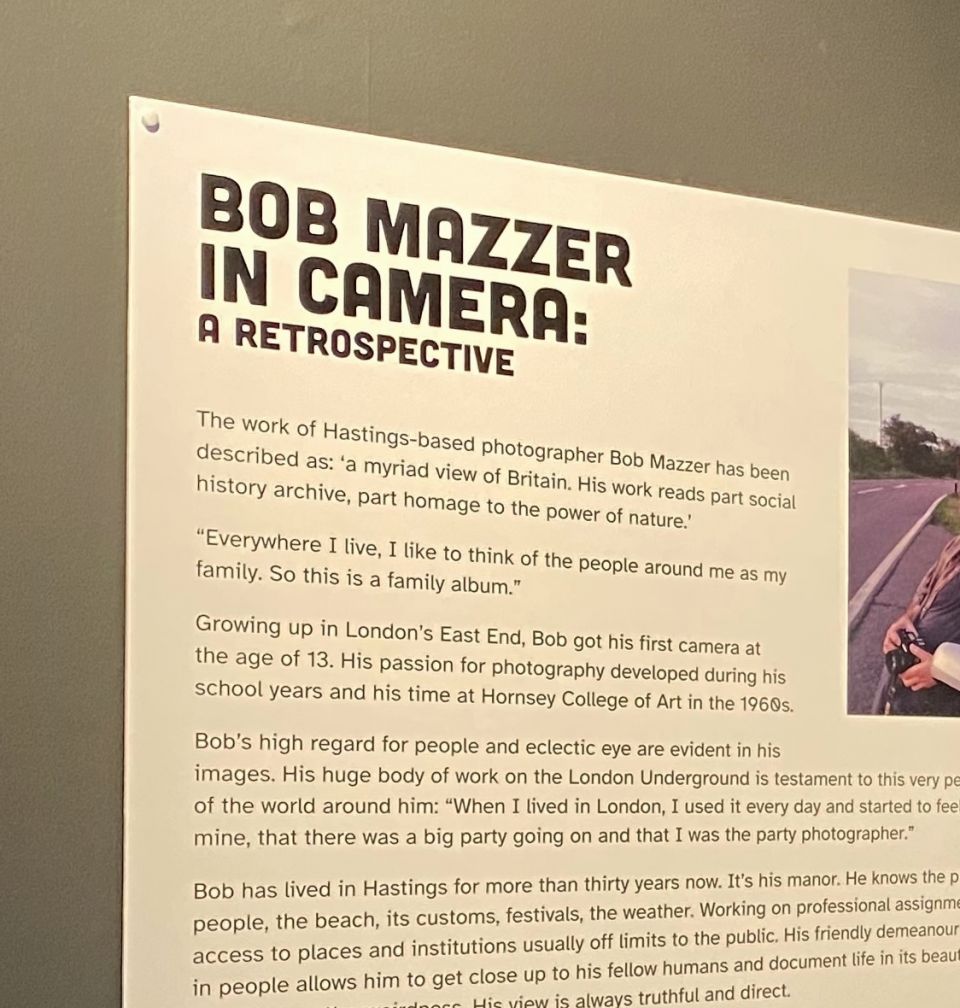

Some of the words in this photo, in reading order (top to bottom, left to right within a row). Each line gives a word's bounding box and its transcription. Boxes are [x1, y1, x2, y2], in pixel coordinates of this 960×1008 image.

[201, 172, 338, 245] BOB
[366, 197, 632, 288] MAZZER
[200, 242, 267, 307] IN
[298, 256, 587, 345] CAMERA:
[198, 313, 219, 344] A
[235, 317, 514, 377] RETROSPECTIVE
[195, 409, 235, 430] The
[241, 417, 290, 435] work
[296, 419, 317, 438] of
[323, 421, 475, 452] Hastings-based
[481, 437, 605, 464] photographer
[610, 449, 644, 468] Bob
[649, 452, 711, 474] Mazzer
[715, 459, 745, 477] has
[749, 462, 790, 482] been
[196, 442, 299, 467] described
[305, 455, 333, 470] as:
[363, 458, 429, 479] myriad
[434, 462, 478, 482] view
[482, 467, 501, 484] of
[507, 469, 572, 491] Britain.
[577, 475, 607, 494] His
[611, 481, 653, 498] work
[658, 485, 705, 502] reads
[710, 490, 744, 506] part
[748, 492, 796, 510] social
[195, 613, 281, 639] Growing
[288, 621, 314, 639] up
[320, 618, 338, 637] in
[440, 625, 481, 644] East
[486, 627, 526, 648] End,
[532, 629, 568, 648] Bob
[573, 634, 602, 652] got
[608, 633, 634, 650] his
[639, 634, 673, 652] first
[678, 640, 740, 655] camera
[744, 641, 761, 656] at
[194, 679, 263, 698] school
[269, 684, 323, 702] years
[329, 683, 366, 701] and
[373, 683, 402, 702] his
[407, 684, 451, 703] time
[456, 688, 475, 704] at
[481, 687, 556, 709] Hornsey
[561, 689, 629, 712] College
[633, 692, 652, 709] of
[656, 693, 682, 710] Art
[687, 693, 703, 710] in
[708, 695, 735, 711] the
[739, 695, 794, 713] 1960s.
[194, 763, 275, 786] images.
[282, 764, 316, 783] His
[322, 765, 372, 787] huge
[377, 766, 425, 787] body
[430, 766, 450, 784] of
[454, 767, 499, 785] work
[504, 771, 527, 785] on
[533, 768, 563, 785] the
[568, 768, 634, 785] London
[640, 768, 750, 790] Underground
[755, 769, 769, 786] is
[774, 771, 853, 786] testament
[857, 772, 873, 787] to
[877, 771, 905, 787] this
[908, 775, 940, 790] very
[193, 913, 269, 936] people,
[275, 912, 309, 930] the
[315, 911, 380, 930] beach,
[386, 909, 410, 927] its
[415, 909, 500, 927] customs,
[505, 905, 584, 924] festivals,
[589, 904, 618, 921] the
[622, 903, 694, 920] weather.
[699, 899, 766, 920] Working
[770, 902, 791, 915] on
[796, 896, 891, 918] professional
[192, 949, 264, 965] access
[270, 945, 291, 962] to
[297, 943, 363, 965] places
[368, 940, 405, 959] and
[411, 936, 517, 957] institutions
[523, 934, 585, 954] usually
[589, 932, 614, 950] off
[619, 931, 667, 949] limits
[671, 932, 689, 947] to
[693, 930, 721, 946] the
[725, 927, 779, 948] public.
[783, 925, 810, 943] His
[814, 924, 872, 943] friendly
[875, 923, 960, 939] demeanour
[637, 986, 700, 1006] truthful
[704, 984, 735, 1002] and
[739, 983, 791, 1000] direct.
